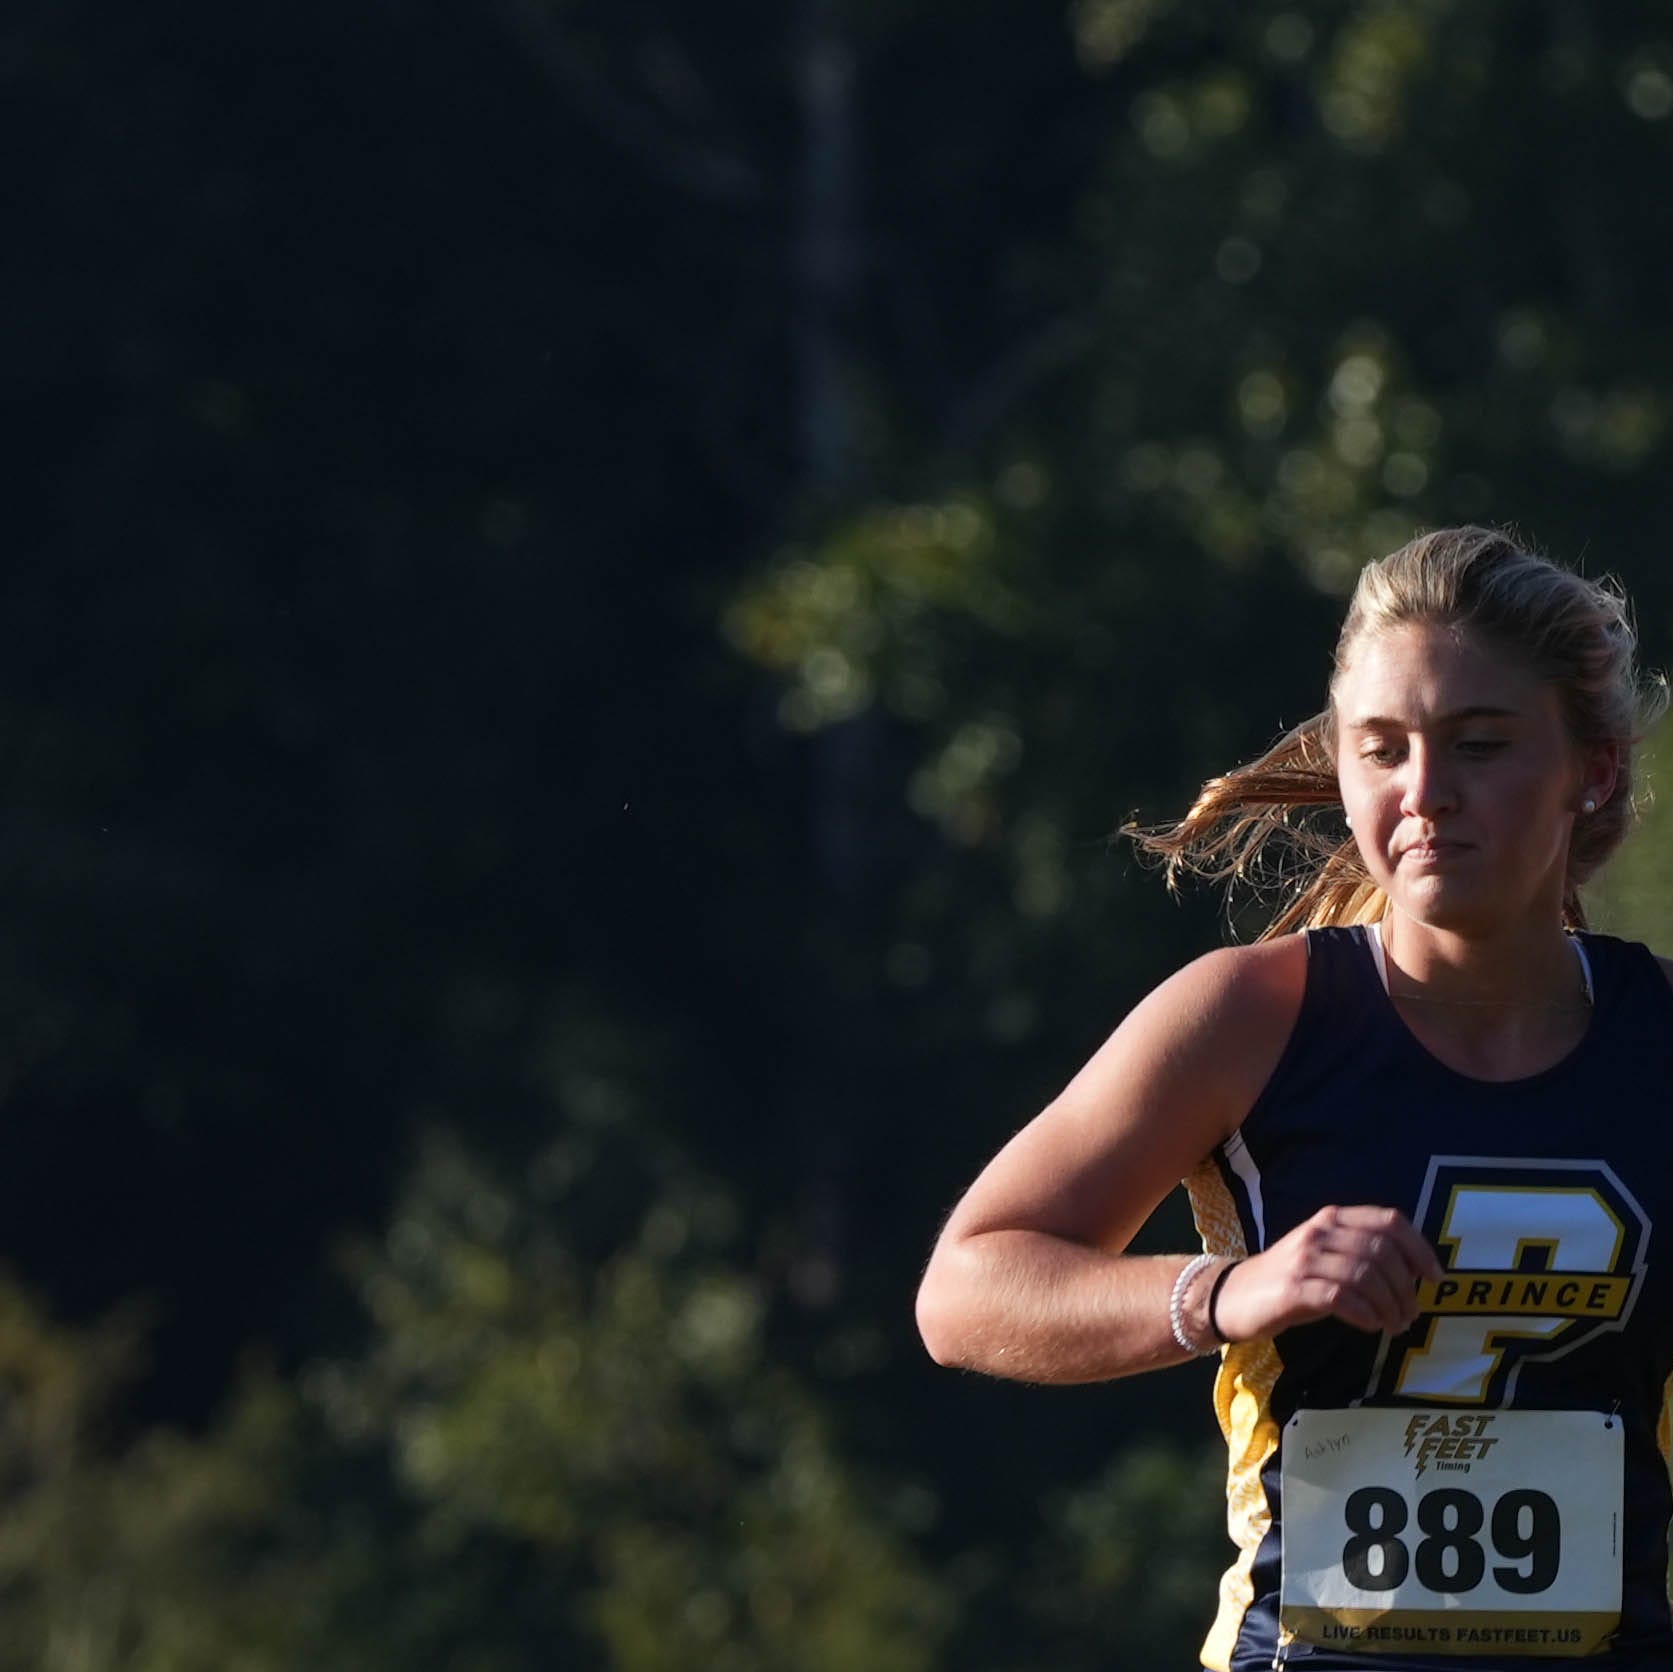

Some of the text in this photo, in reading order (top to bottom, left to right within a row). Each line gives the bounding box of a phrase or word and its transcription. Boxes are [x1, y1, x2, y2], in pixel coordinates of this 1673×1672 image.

[1433, 1280, 1612, 1310] PRINCE
[1404, 1414, 1496, 1442] FAST
[1416, 1437, 1500, 1464] FEET
[1435, 1461, 1471, 1474] Timing
[1342, 1486, 1561, 1595] 889
[1323, 1625, 1582, 1644] LIVE RESULTS FASTFEET.US
